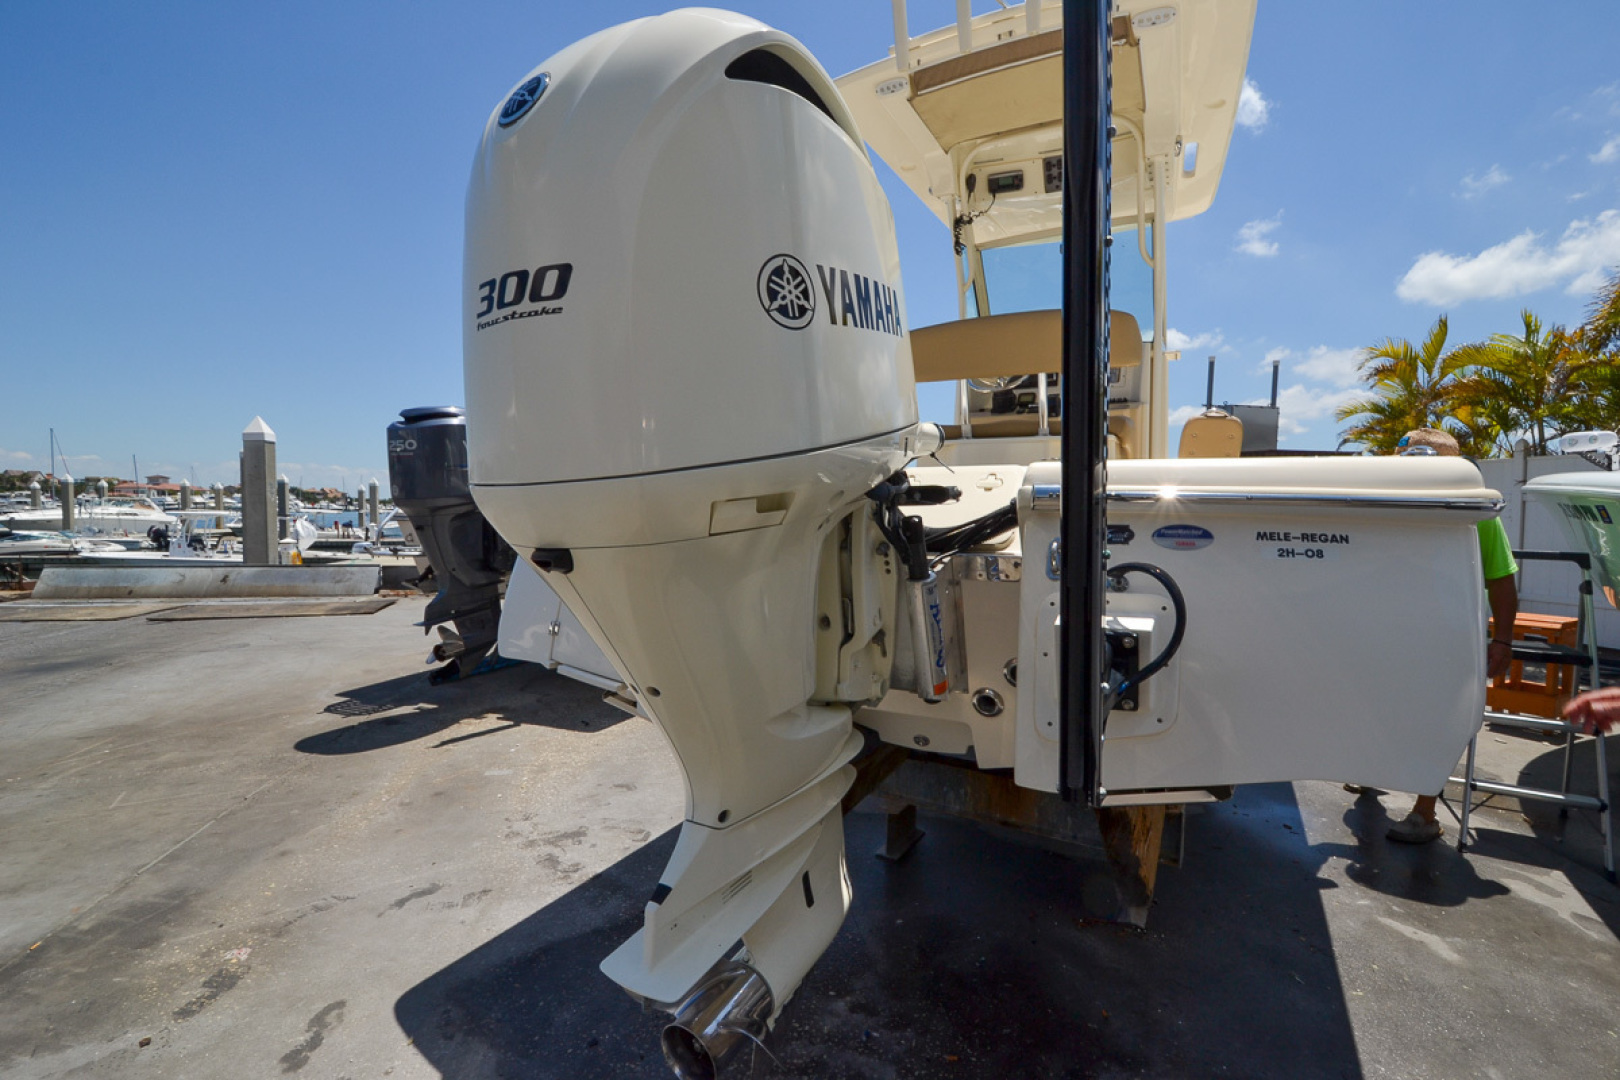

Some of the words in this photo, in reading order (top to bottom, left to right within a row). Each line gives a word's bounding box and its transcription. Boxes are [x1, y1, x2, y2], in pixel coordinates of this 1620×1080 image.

[477, 262, 573, 319] 300
[816, 264, 903, 338] YAMAHA
[389, 439, 417, 451] 250
[1256, 531, 1349, 544] MELE-REGAN
